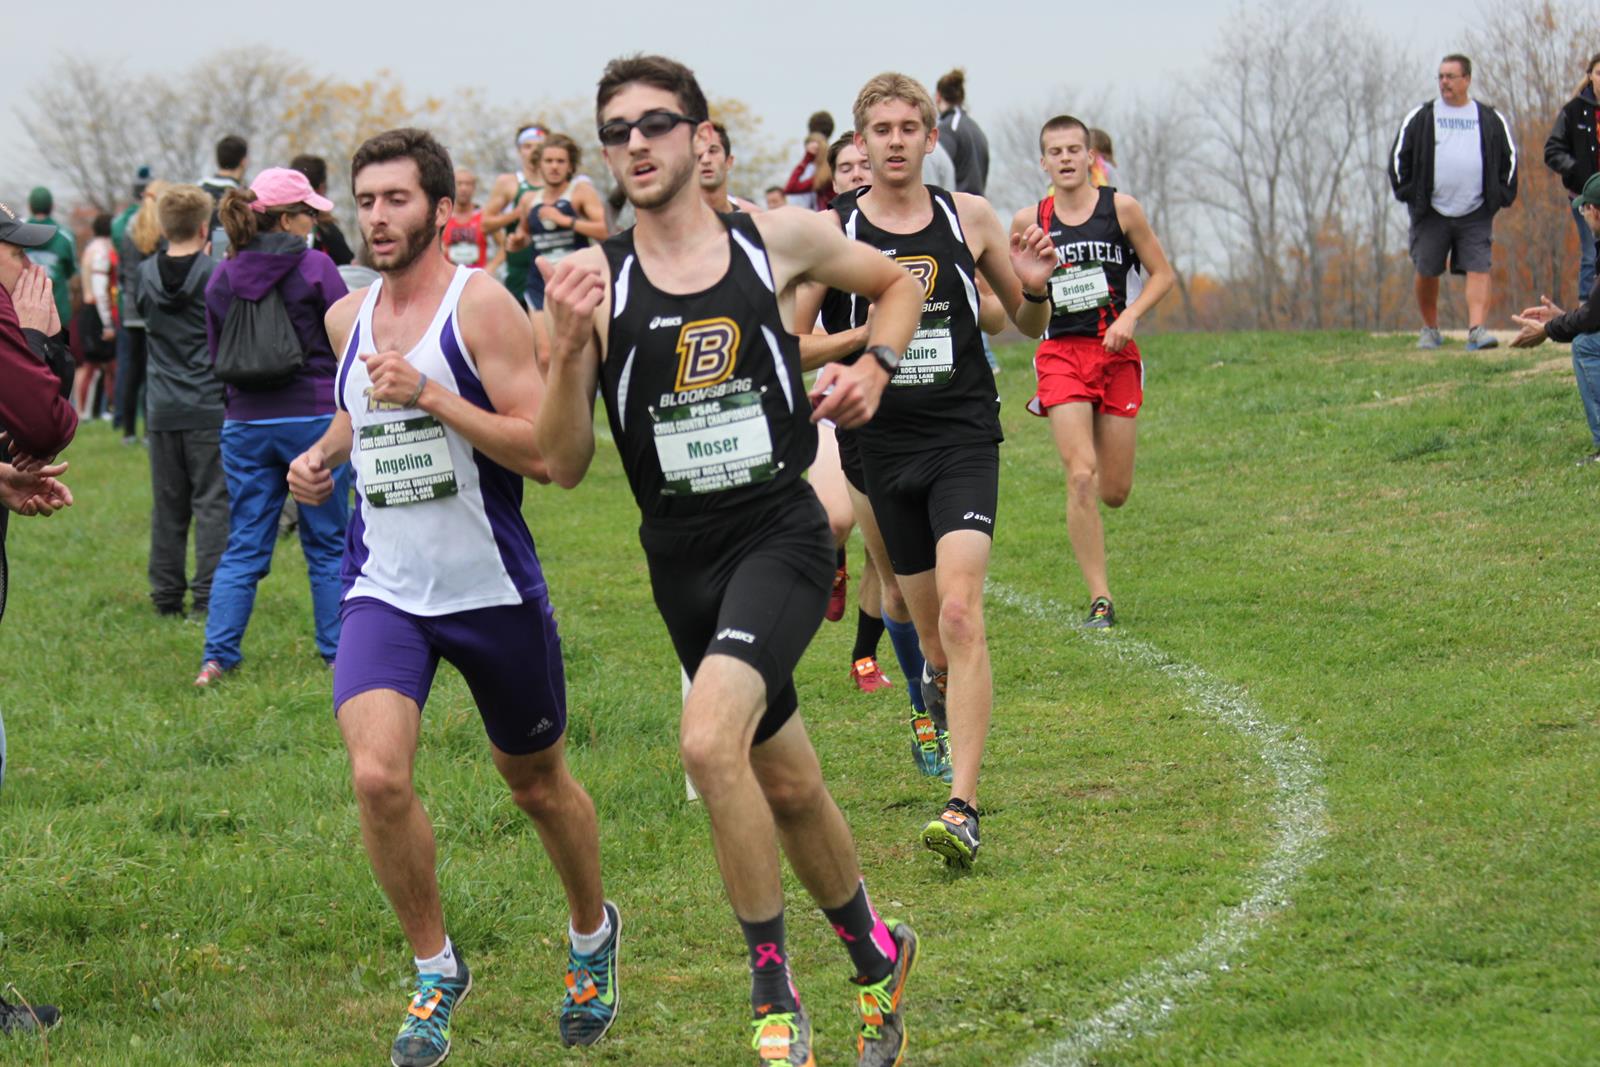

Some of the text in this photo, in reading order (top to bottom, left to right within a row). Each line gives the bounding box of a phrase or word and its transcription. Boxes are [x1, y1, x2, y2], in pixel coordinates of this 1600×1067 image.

[1054, 240, 1123, 269] NSFIELD
[1062, 282, 1095, 296] Bridges
[675, 315, 742, 392] B
[902, 347, 937, 360] Guire
[690, 402, 721, 417] PSAC
[374, 434, 396, 447] COUNTRY
[396, 426, 443, 444] CHAMPIONSHIPS
[384, 422, 406, 435] PSAC
[687, 436, 739, 459] Moser
[375, 453, 433, 475] Angelina
[366, 471, 454, 495] SLIPPERY ROCK UNIVERSITY
